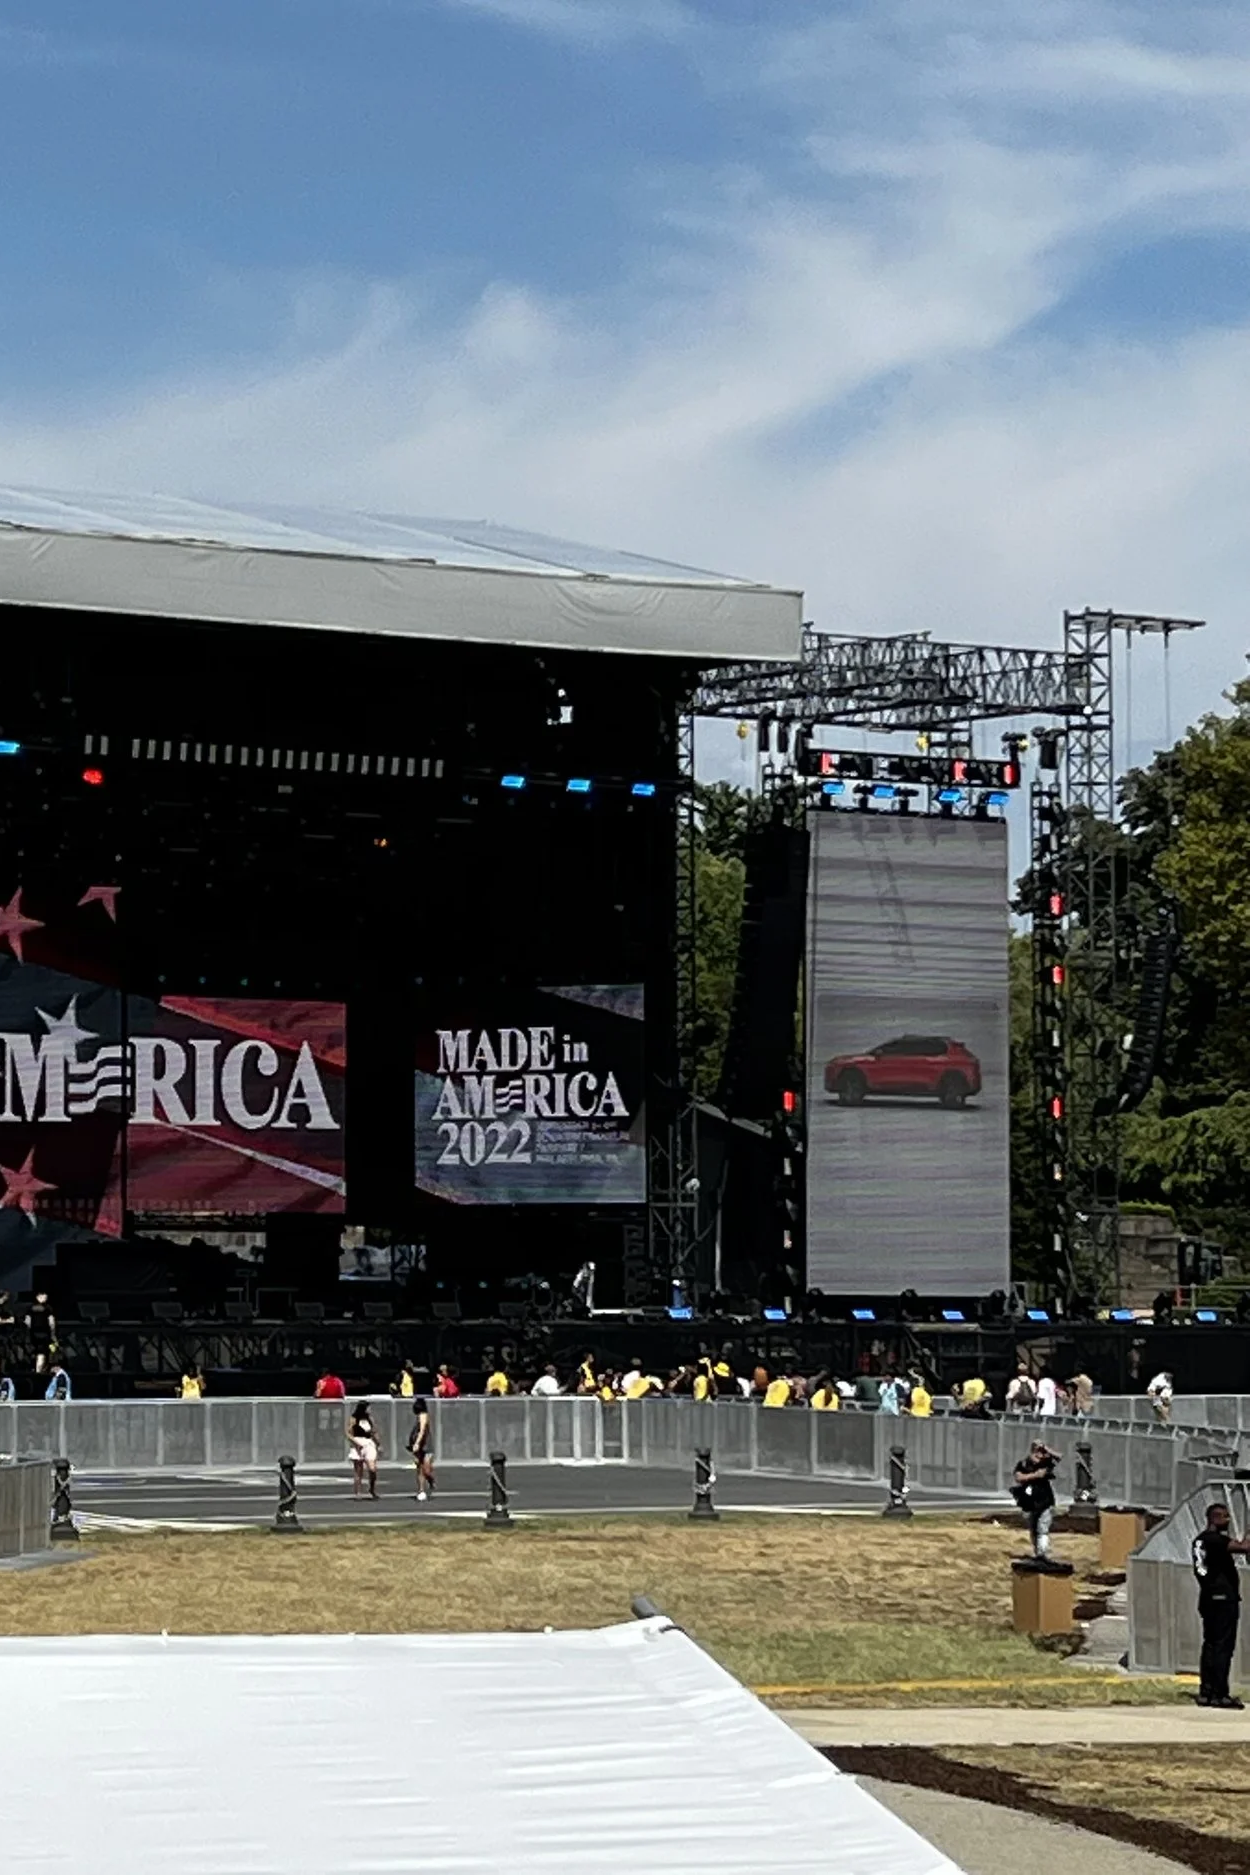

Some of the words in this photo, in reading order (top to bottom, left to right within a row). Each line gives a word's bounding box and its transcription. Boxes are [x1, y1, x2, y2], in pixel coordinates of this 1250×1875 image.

[435, 1026, 556, 1074] MADE
[562, 1034, 589, 1063] in
[431, 1071, 630, 1121] AMERICA
[436, 1121, 532, 1167] 2022
